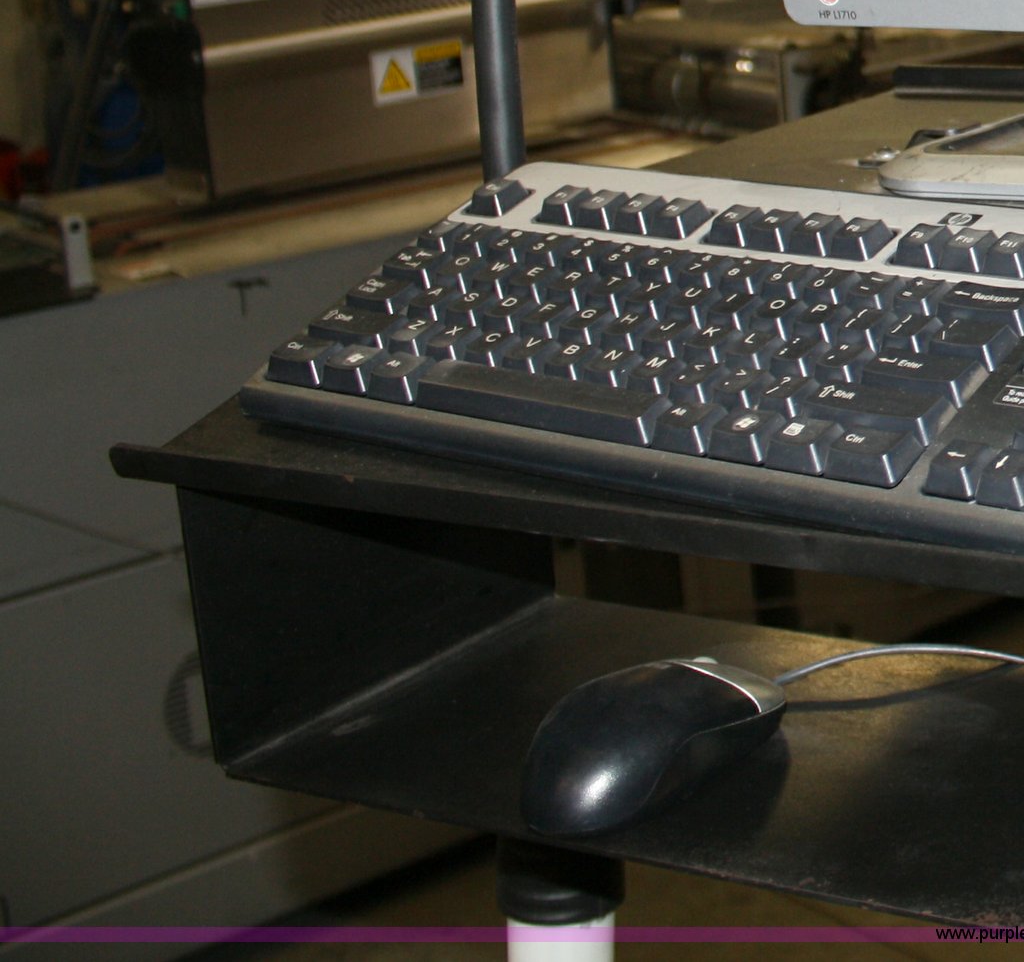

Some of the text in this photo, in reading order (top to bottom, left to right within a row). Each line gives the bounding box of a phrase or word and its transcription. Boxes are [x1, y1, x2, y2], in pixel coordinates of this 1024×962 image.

[818, 10, 831, 18] HP
[496, 238, 510, 247] 2
[532, 242, 546, 251] 3
[1000, 240, 1018, 248] F11
[570, 248, 582, 256] 4
[608, 253, 621, 262] 5
[647, 258, 660, 266] 6
[490, 262, 510, 272] W
[526, 266, 544, 277] E
[728, 268, 741, 276] 8
[564, 270, 582, 282] R
[606, 276, 622, 286] T
[770, 272, 783, 282] 9
[428, 288, 444, 296] A
[646, 282, 662, 292] Y
[464, 292, 480, 302] S
[684, 288, 702, 298] U
[971, 292, 1020, 304] Backspace
[501, 296, 518, 307] D
[538, 303, 556, 312] F
[810, 304, 828, 314] P
[580, 308, 597, 319] G
[620, 314, 639, 324] H
[408, 320, 427, 330] Z
[660, 322, 676, 332] J
[444, 326, 464, 336] X
[702, 326, 720, 337] K
[485, 332, 502, 343] C
[526, 337, 542, 348] V
[562, 344, 580, 355] B
[604, 350, 624, 361] N
[645, 356, 668, 368] M
[896, 358, 924, 370] Enter
[844, 433, 866, 444] Ctrl
